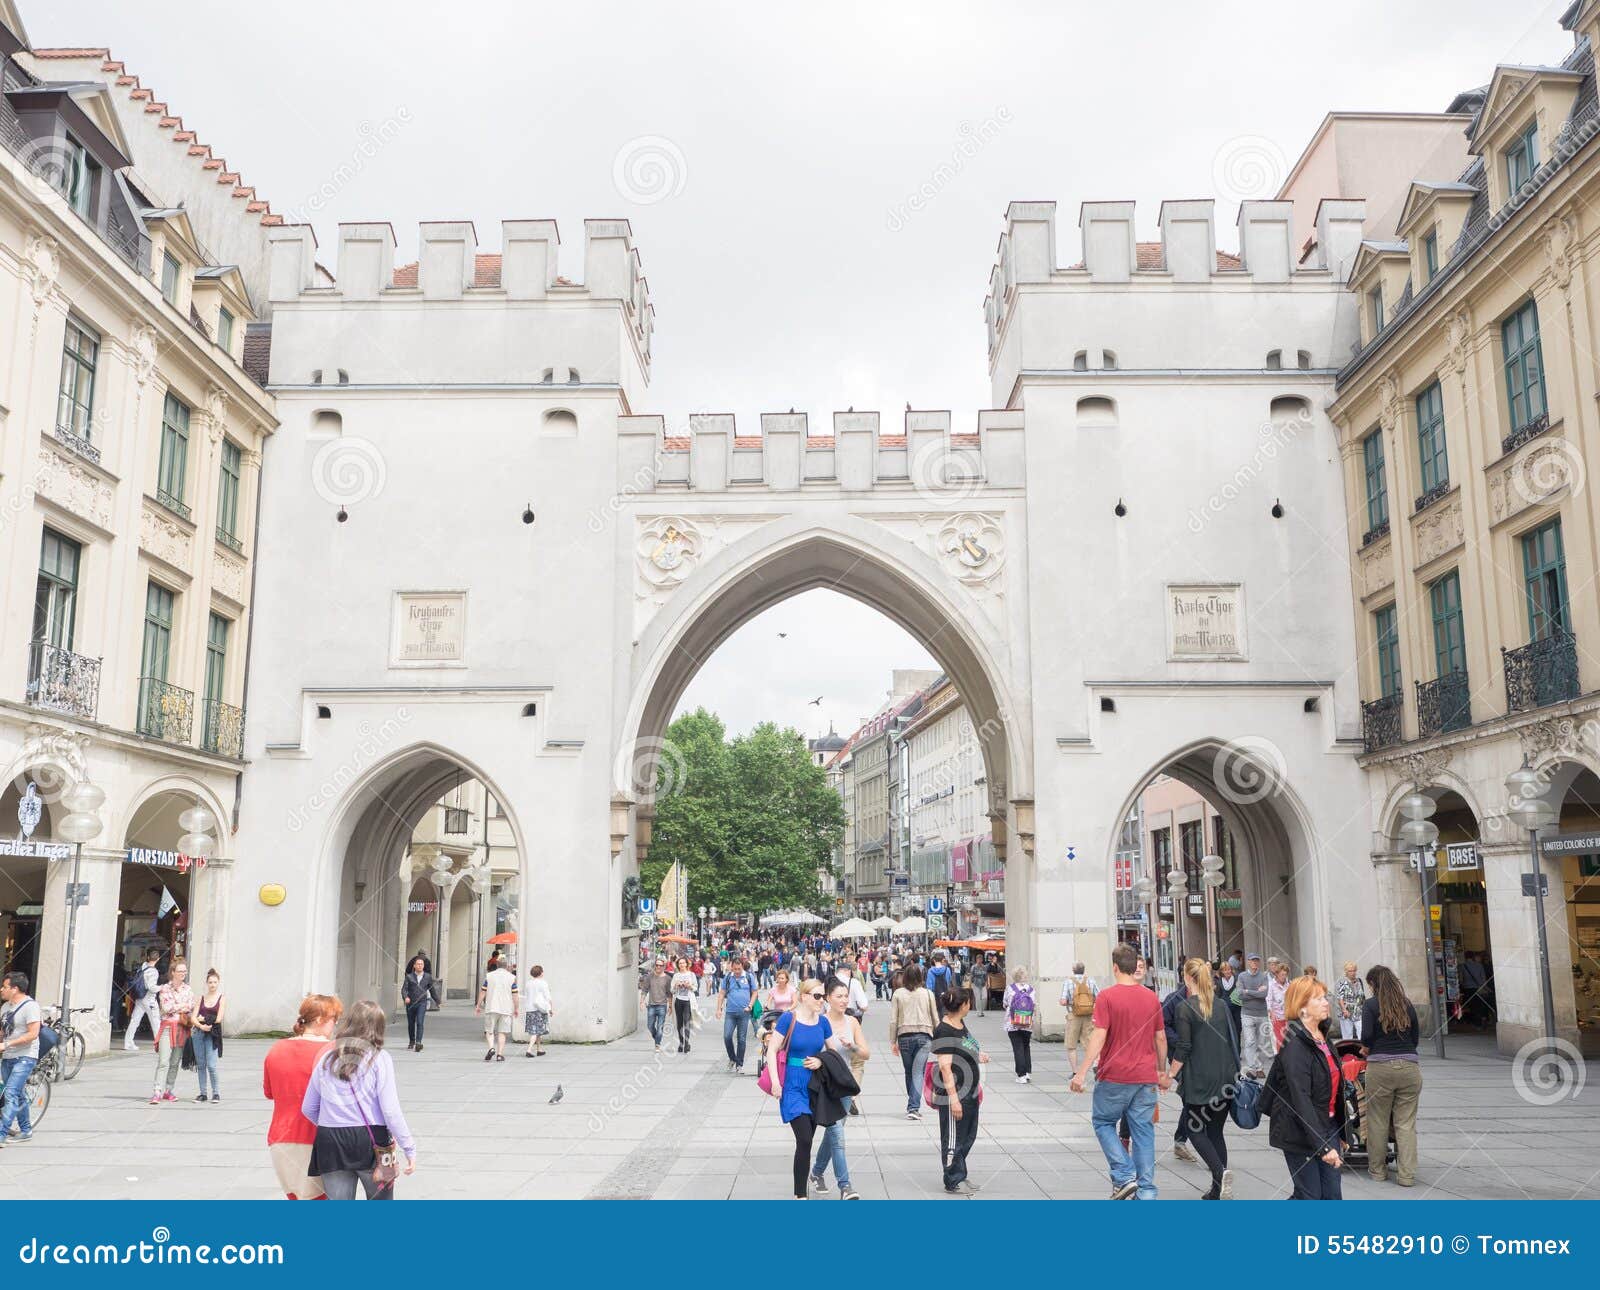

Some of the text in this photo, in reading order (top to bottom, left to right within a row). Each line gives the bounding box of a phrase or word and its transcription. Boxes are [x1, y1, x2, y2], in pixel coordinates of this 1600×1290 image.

[1543, 841, 1563, 851] UNITED
[1564, 839, 1586, 850] COLORS
[1587, 838, 1595, 848] OF
[131, 848, 178, 866] KARSTADT
[1449, 848, 1474, 865] BASE
[640, 899, 652, 911] U
[930, 899, 941, 911] U
